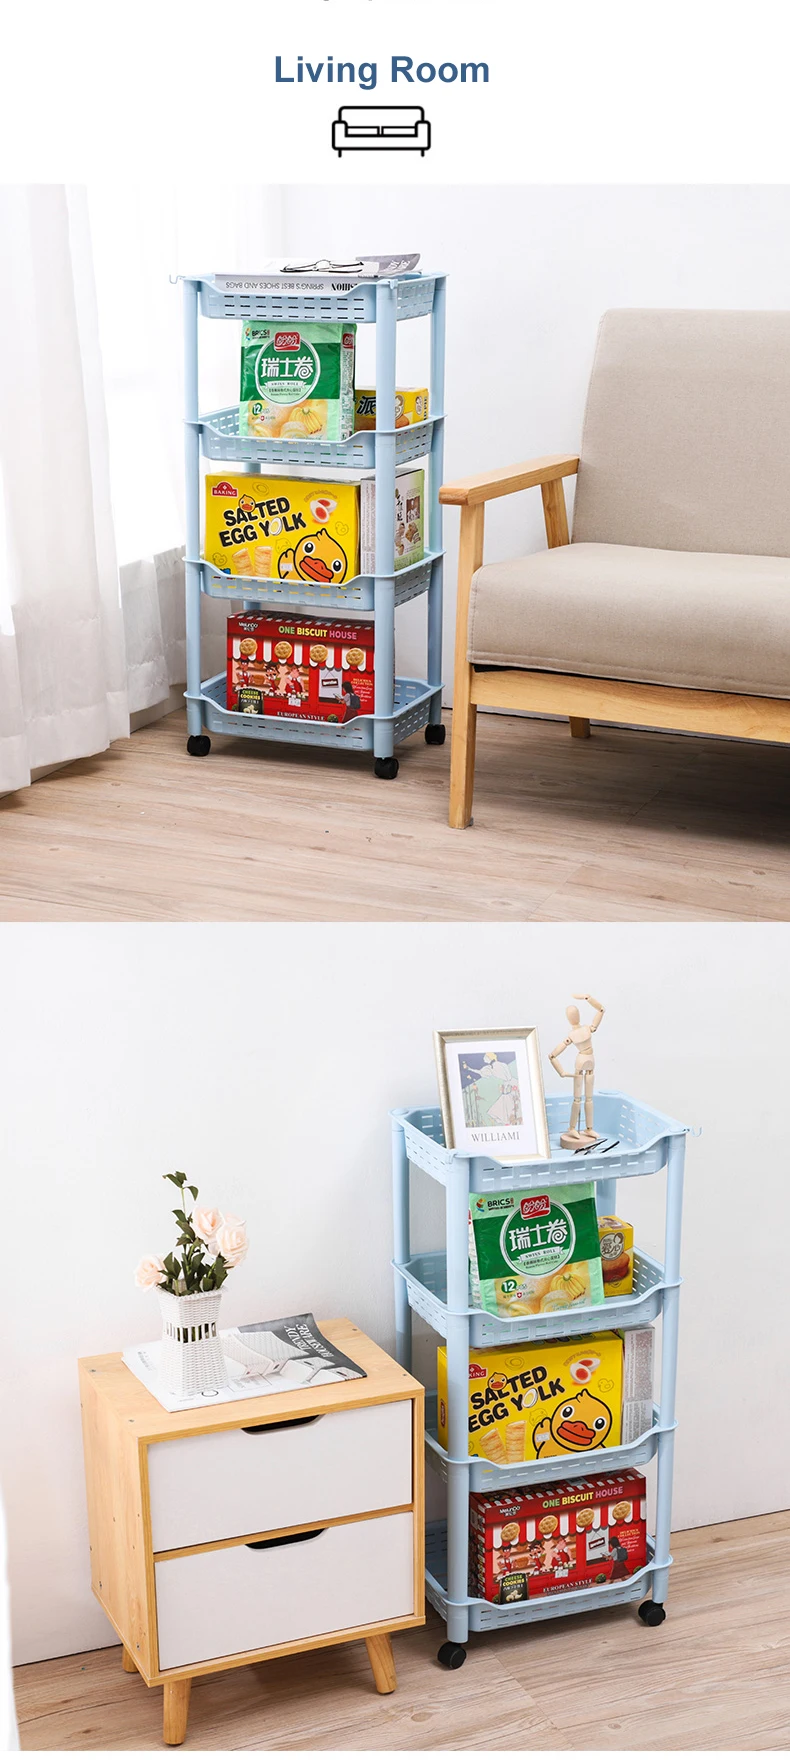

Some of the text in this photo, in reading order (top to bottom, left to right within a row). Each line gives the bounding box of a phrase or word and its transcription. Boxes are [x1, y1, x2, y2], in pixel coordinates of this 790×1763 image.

[260, 356, 314, 379] 瑞士卷
[253, 403, 261, 414] 12
[223, 497, 290, 527] SALTED
[219, 512, 307, 547] EGG YOLK
[278, 625, 357, 640] ONE BISCUIT HOUSE
[277, 711, 307, 719] EUROPEAN
[487, 1198, 511, 1207] BRICS
[508, 1218, 569, 1252] 瑞士卷
[502, 1281, 515, 1292] 12
[470, 1365, 548, 1410] SALTED
[468, 1402, 509, 1432] EGG
[510, 1377, 565, 1411] YOLK
[542, 1486, 624, 1509] ONE BISCUIT HOUSE
[543, 1582, 574, 1592] EUROPEAN
[575, 1578, 592, 1586] STYLE
